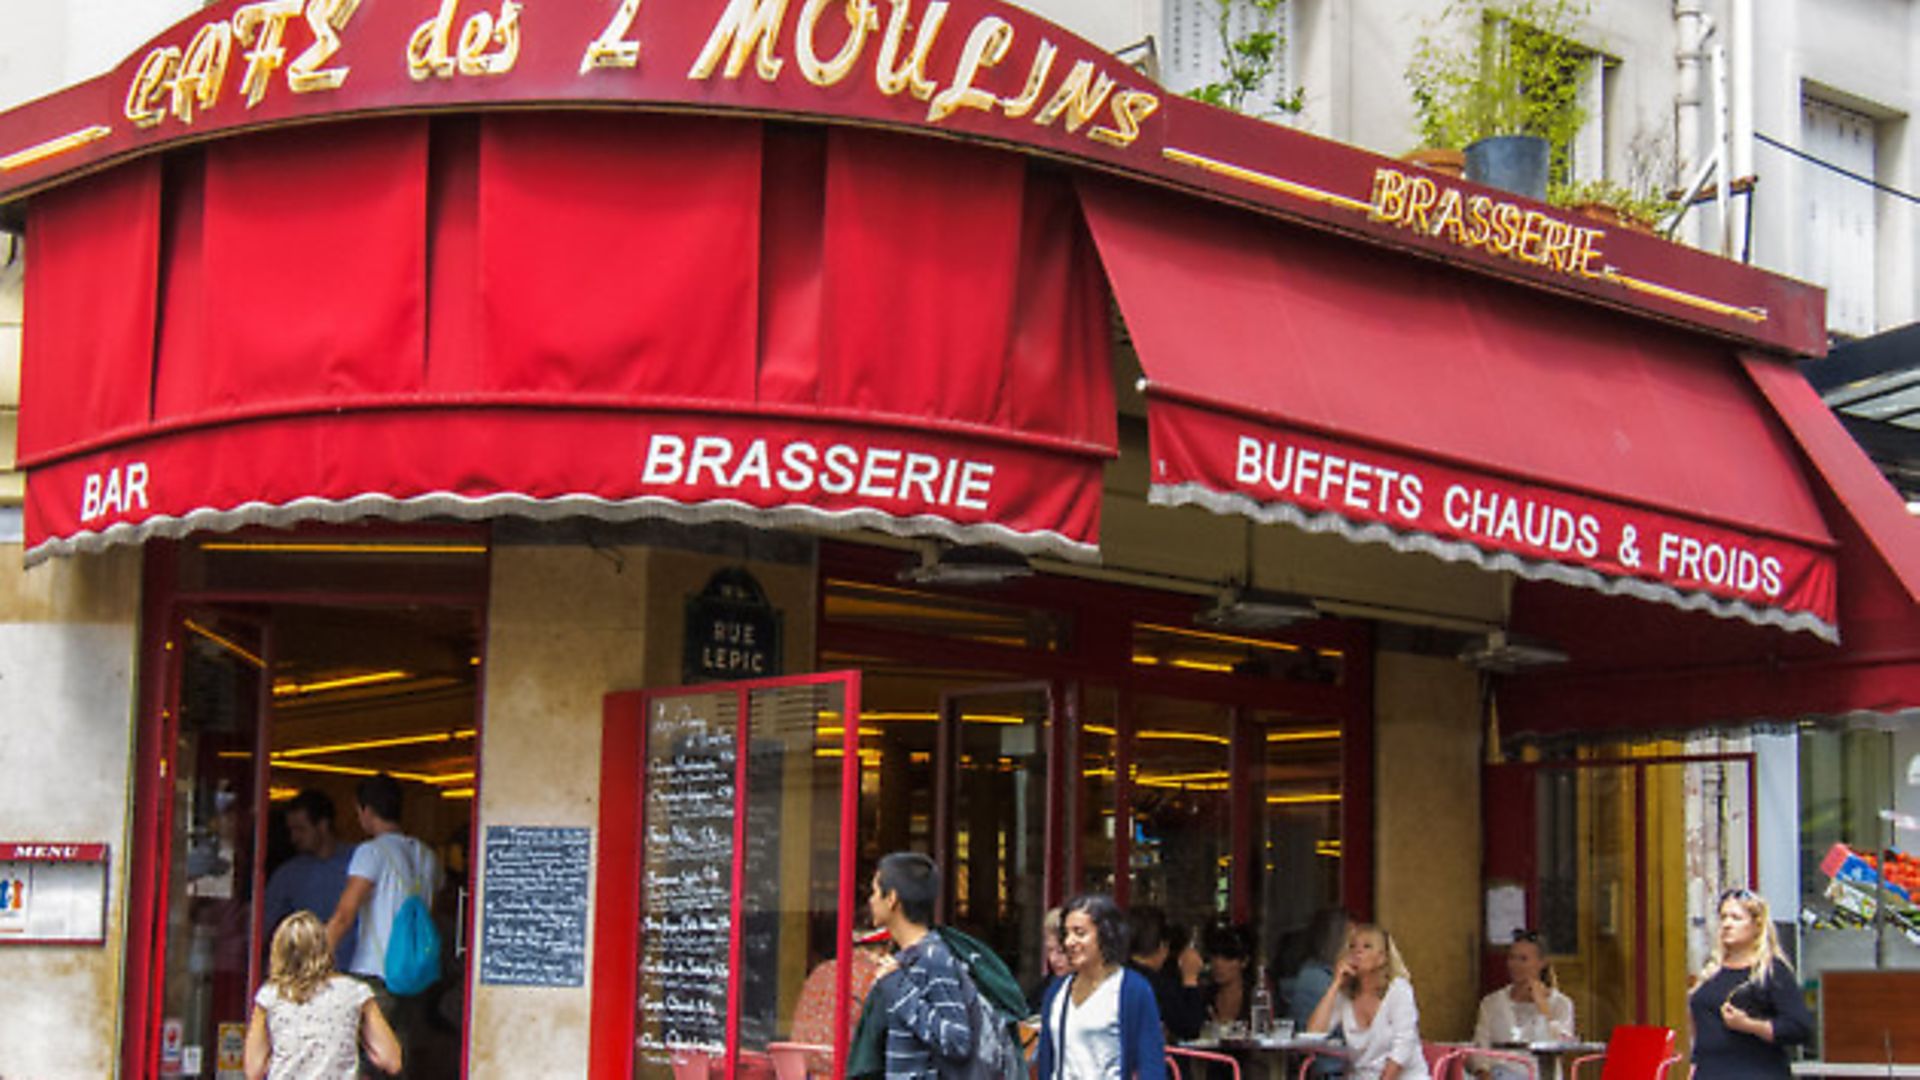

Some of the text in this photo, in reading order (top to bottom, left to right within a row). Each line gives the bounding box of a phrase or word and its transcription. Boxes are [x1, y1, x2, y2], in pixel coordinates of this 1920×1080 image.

[406, 0, 524, 81] des
[687, 0, 1159, 147] MOULINS
[1367, 167, 1606, 279] BRASSERIE
[80, 462, 149, 522] BAR
[641, 434, 995, 511] BRASSERIE
[1235, 434, 1783, 597] BUFFETS CHAUDS & FROIDS
[702, 647, 764, 673] LEPIC
[714, 621, 756, 645] RUE
[14, 845, 79, 859] MENU
